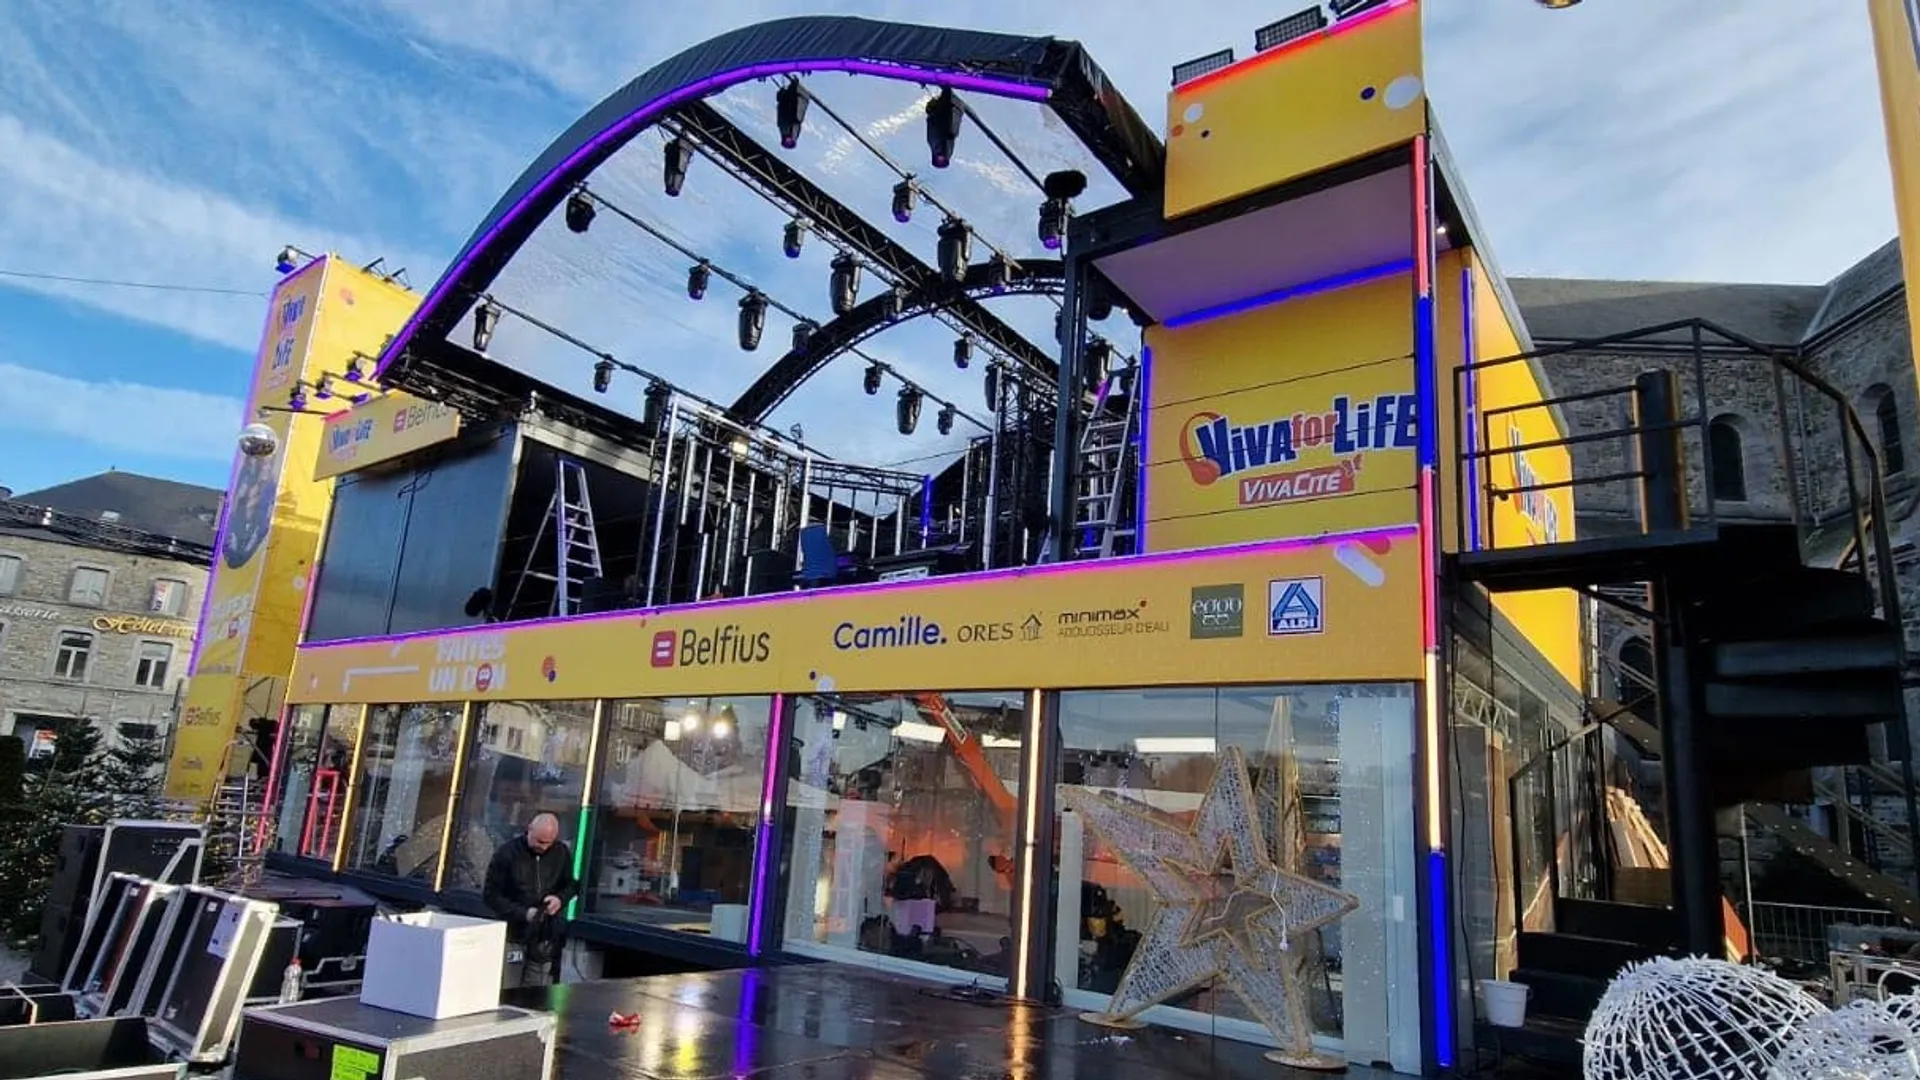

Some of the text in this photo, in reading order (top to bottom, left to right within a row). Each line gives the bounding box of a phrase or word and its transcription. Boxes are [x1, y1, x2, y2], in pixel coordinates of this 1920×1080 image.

[1058, 608, 1141, 624] minimax
[1275, 617, 1316, 630] ALDI
[834, 616, 947, 649] Camille.
[957, 622, 1014, 643] ORES
[680, 624, 770, 666] Belfius
